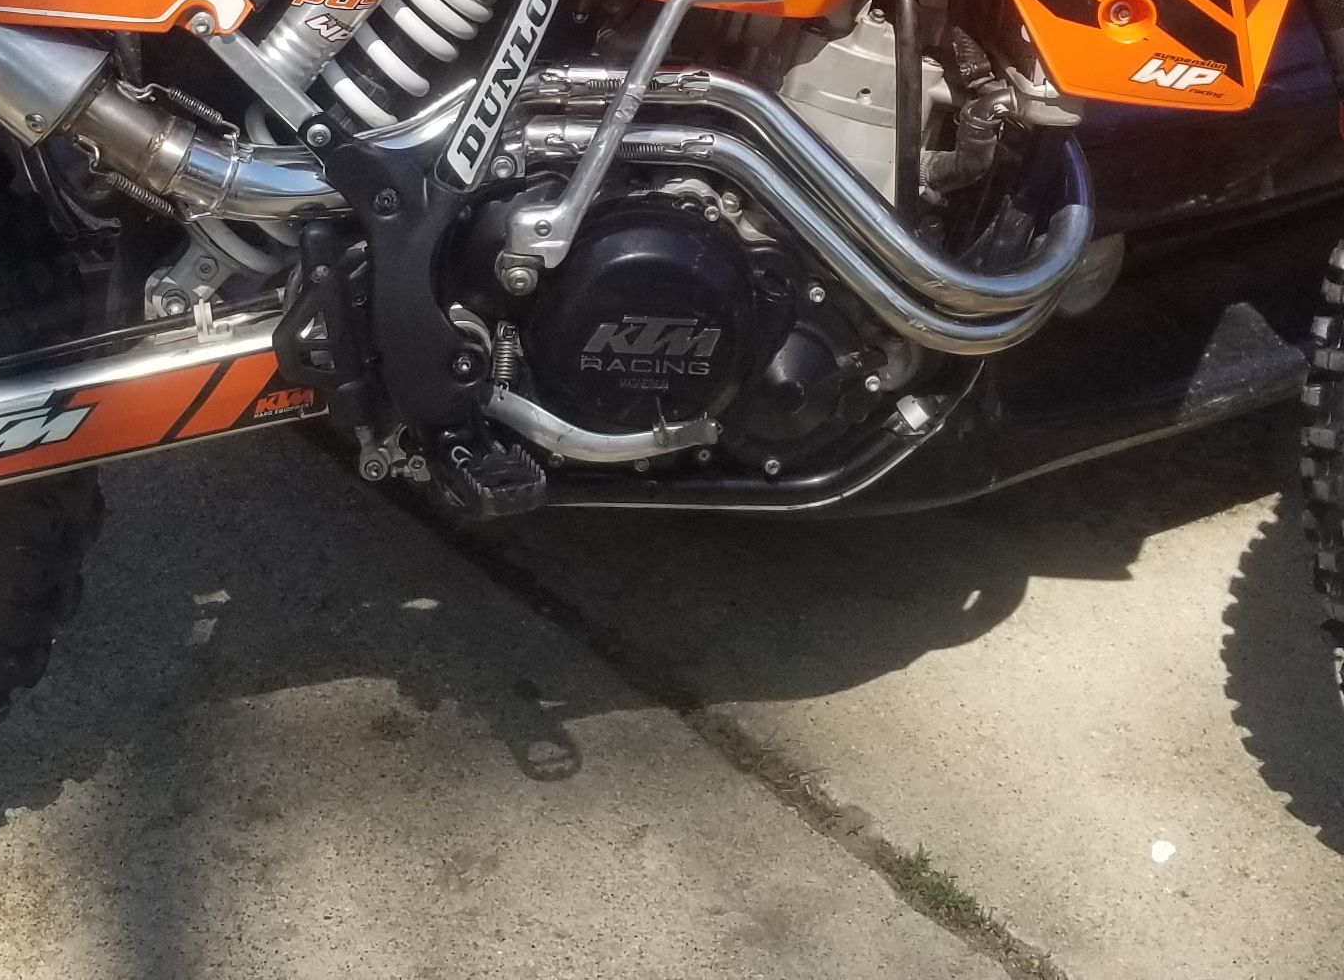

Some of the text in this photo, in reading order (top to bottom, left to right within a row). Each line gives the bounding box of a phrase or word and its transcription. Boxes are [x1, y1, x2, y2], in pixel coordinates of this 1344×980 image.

[1129, 56, 1222, 91] WP
[582, 315, 722, 357] KTM
[580, 355, 710, 376] RACING
